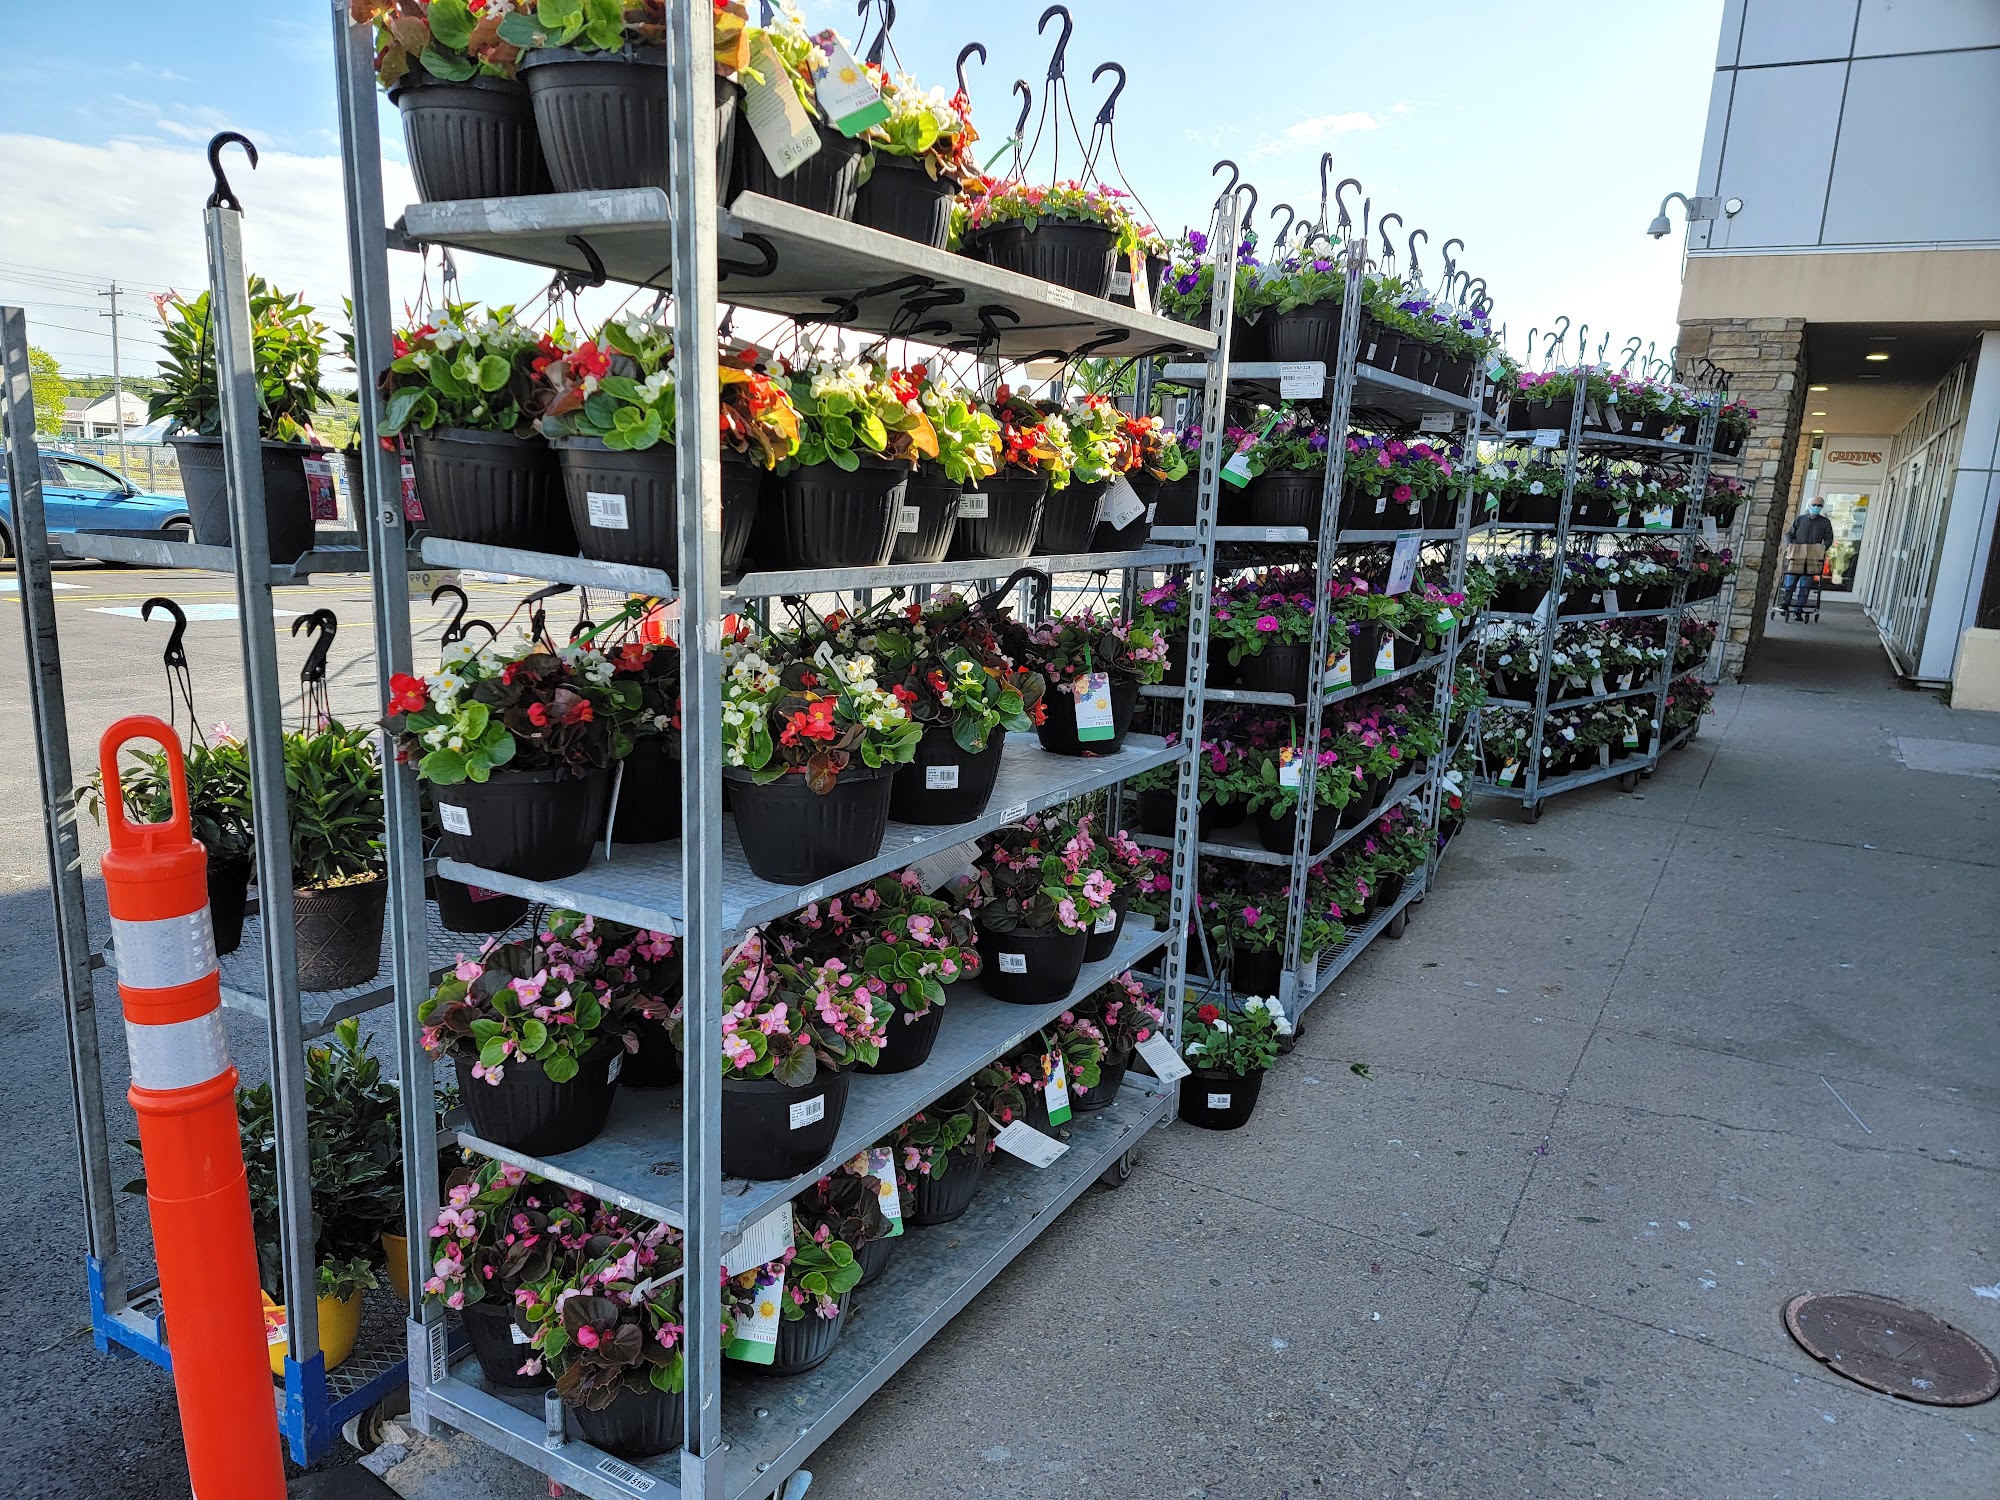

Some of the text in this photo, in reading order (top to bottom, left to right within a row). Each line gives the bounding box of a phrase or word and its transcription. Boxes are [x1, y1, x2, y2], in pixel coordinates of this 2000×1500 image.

[855, 98, 868, 107] FULL
[1828, 451, 1882, 464] GRIFFINS
[753, 1333, 765, 1341] FULL
[631, 1478, 650, 1490] 5109
